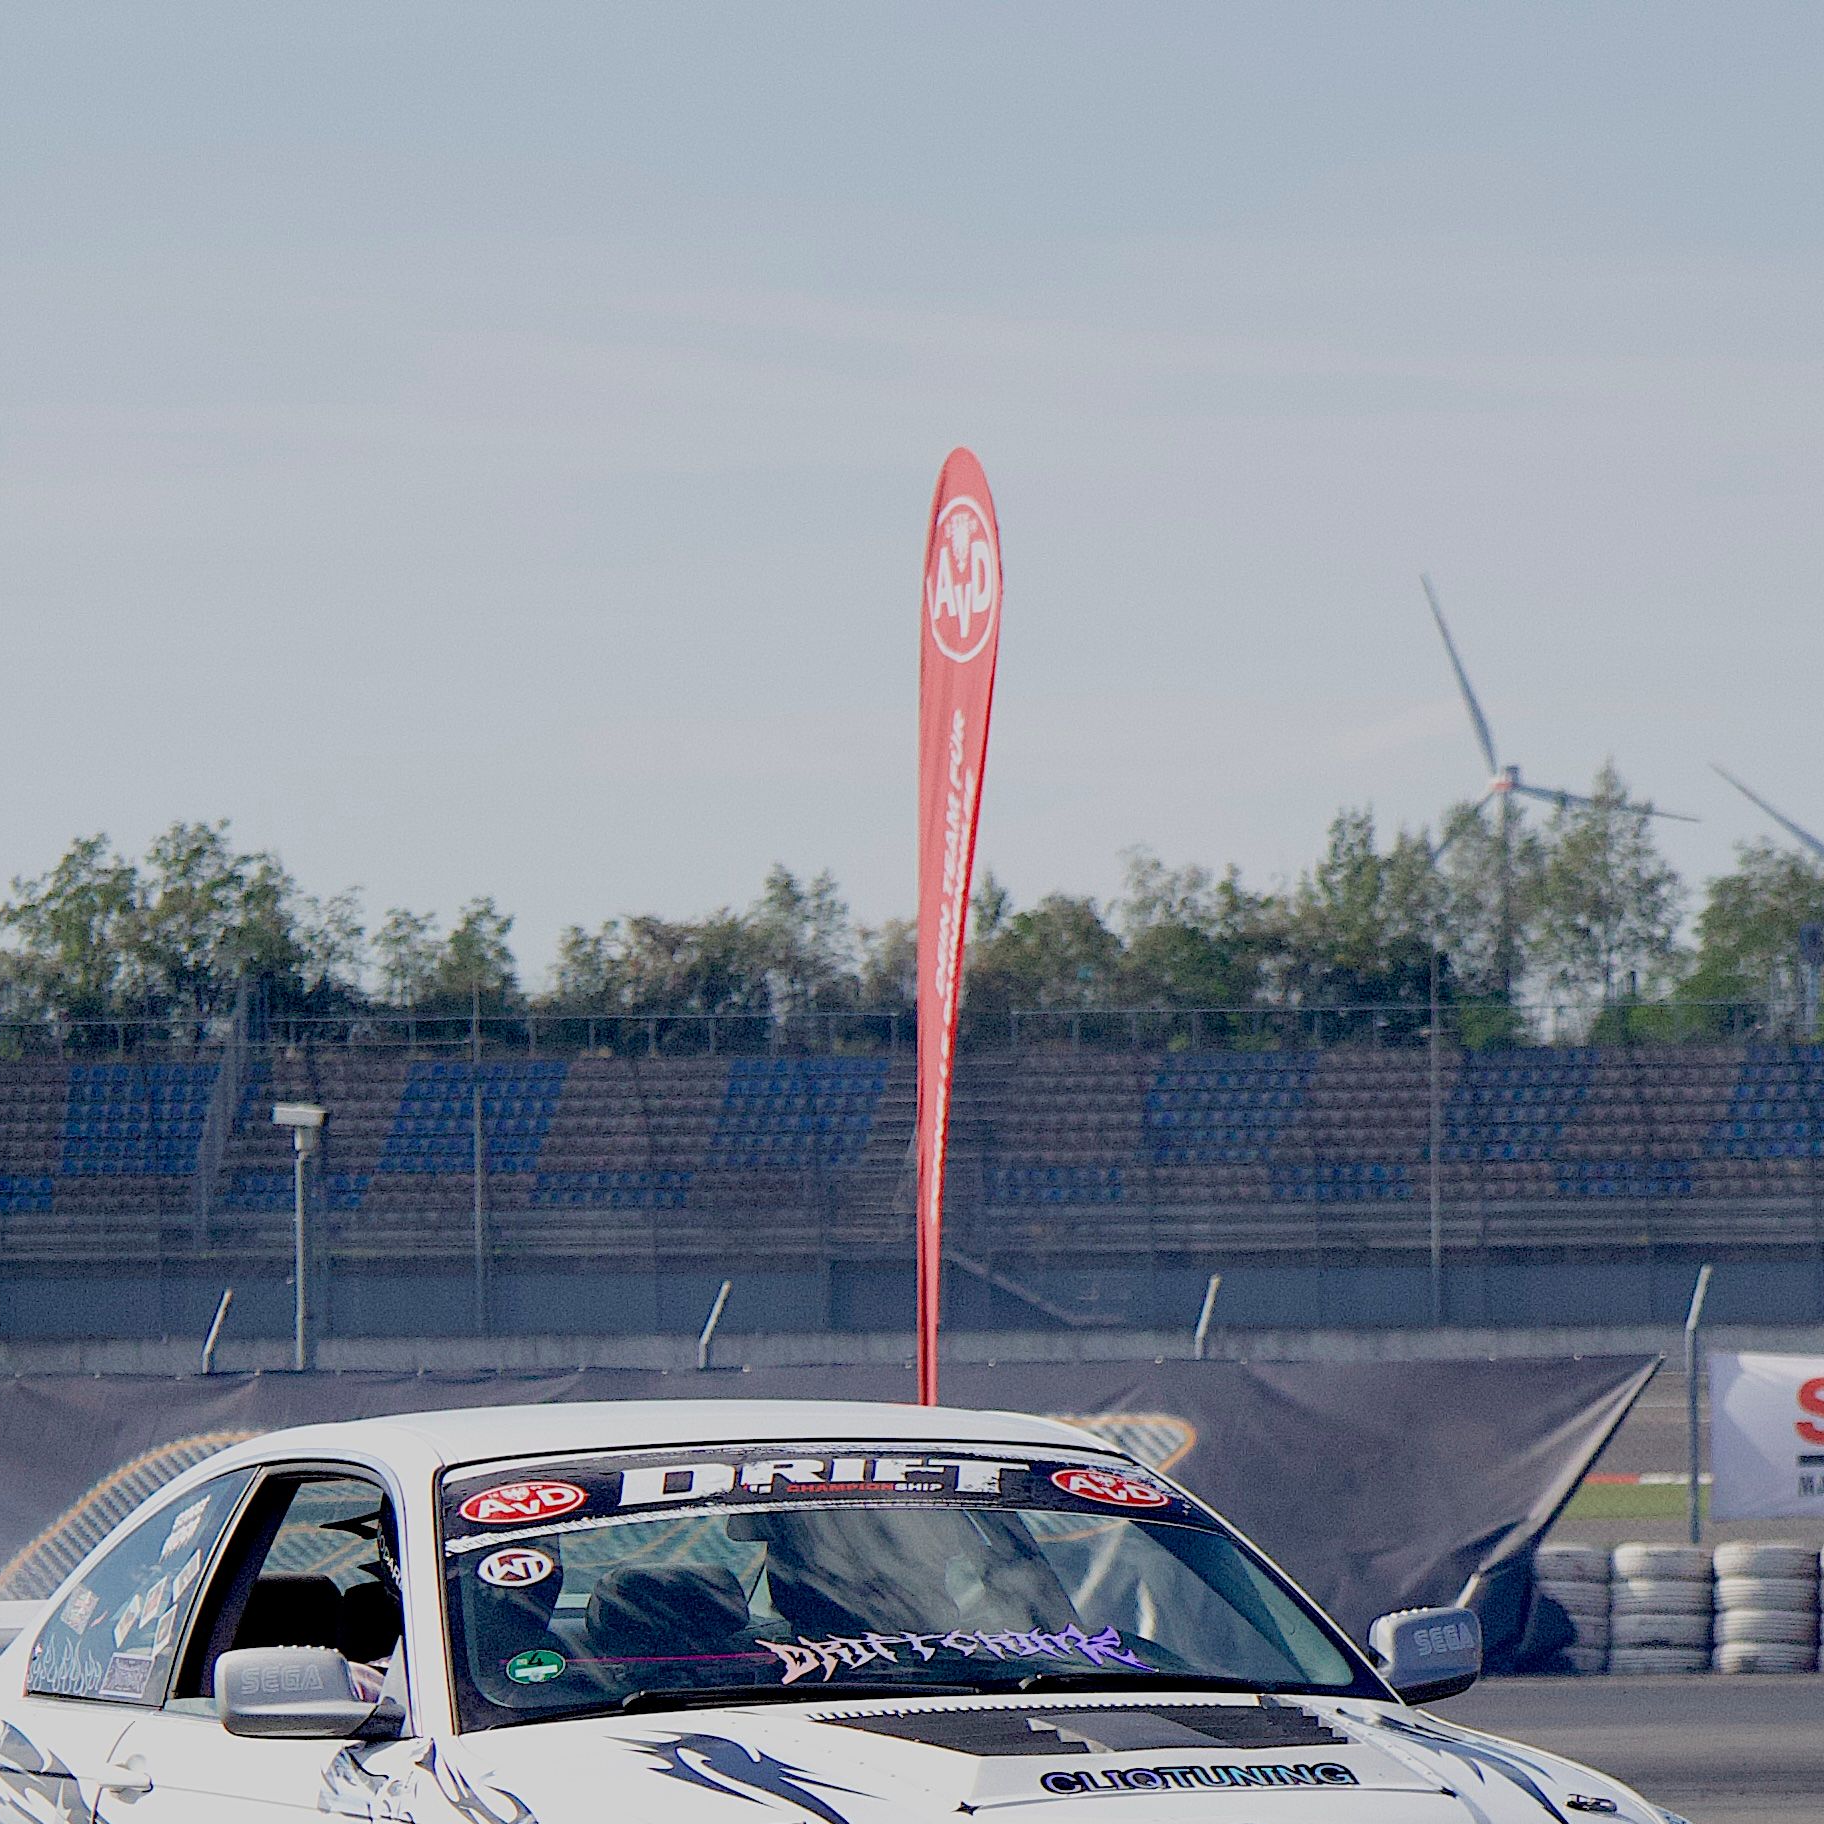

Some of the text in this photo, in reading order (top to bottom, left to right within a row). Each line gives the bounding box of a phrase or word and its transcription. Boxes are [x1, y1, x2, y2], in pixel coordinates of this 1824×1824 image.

[942, 792, 962, 896] TEAM
[619, 1458, 1030, 1507] DRIFT
[786, 1481, 944, 1494] CHAMPIONSHIP
[1414, 1622, 1475, 1657] SEGA
[527, 1651, 544, 1666] 4
[240, 1663, 325, 1695] SEGA
